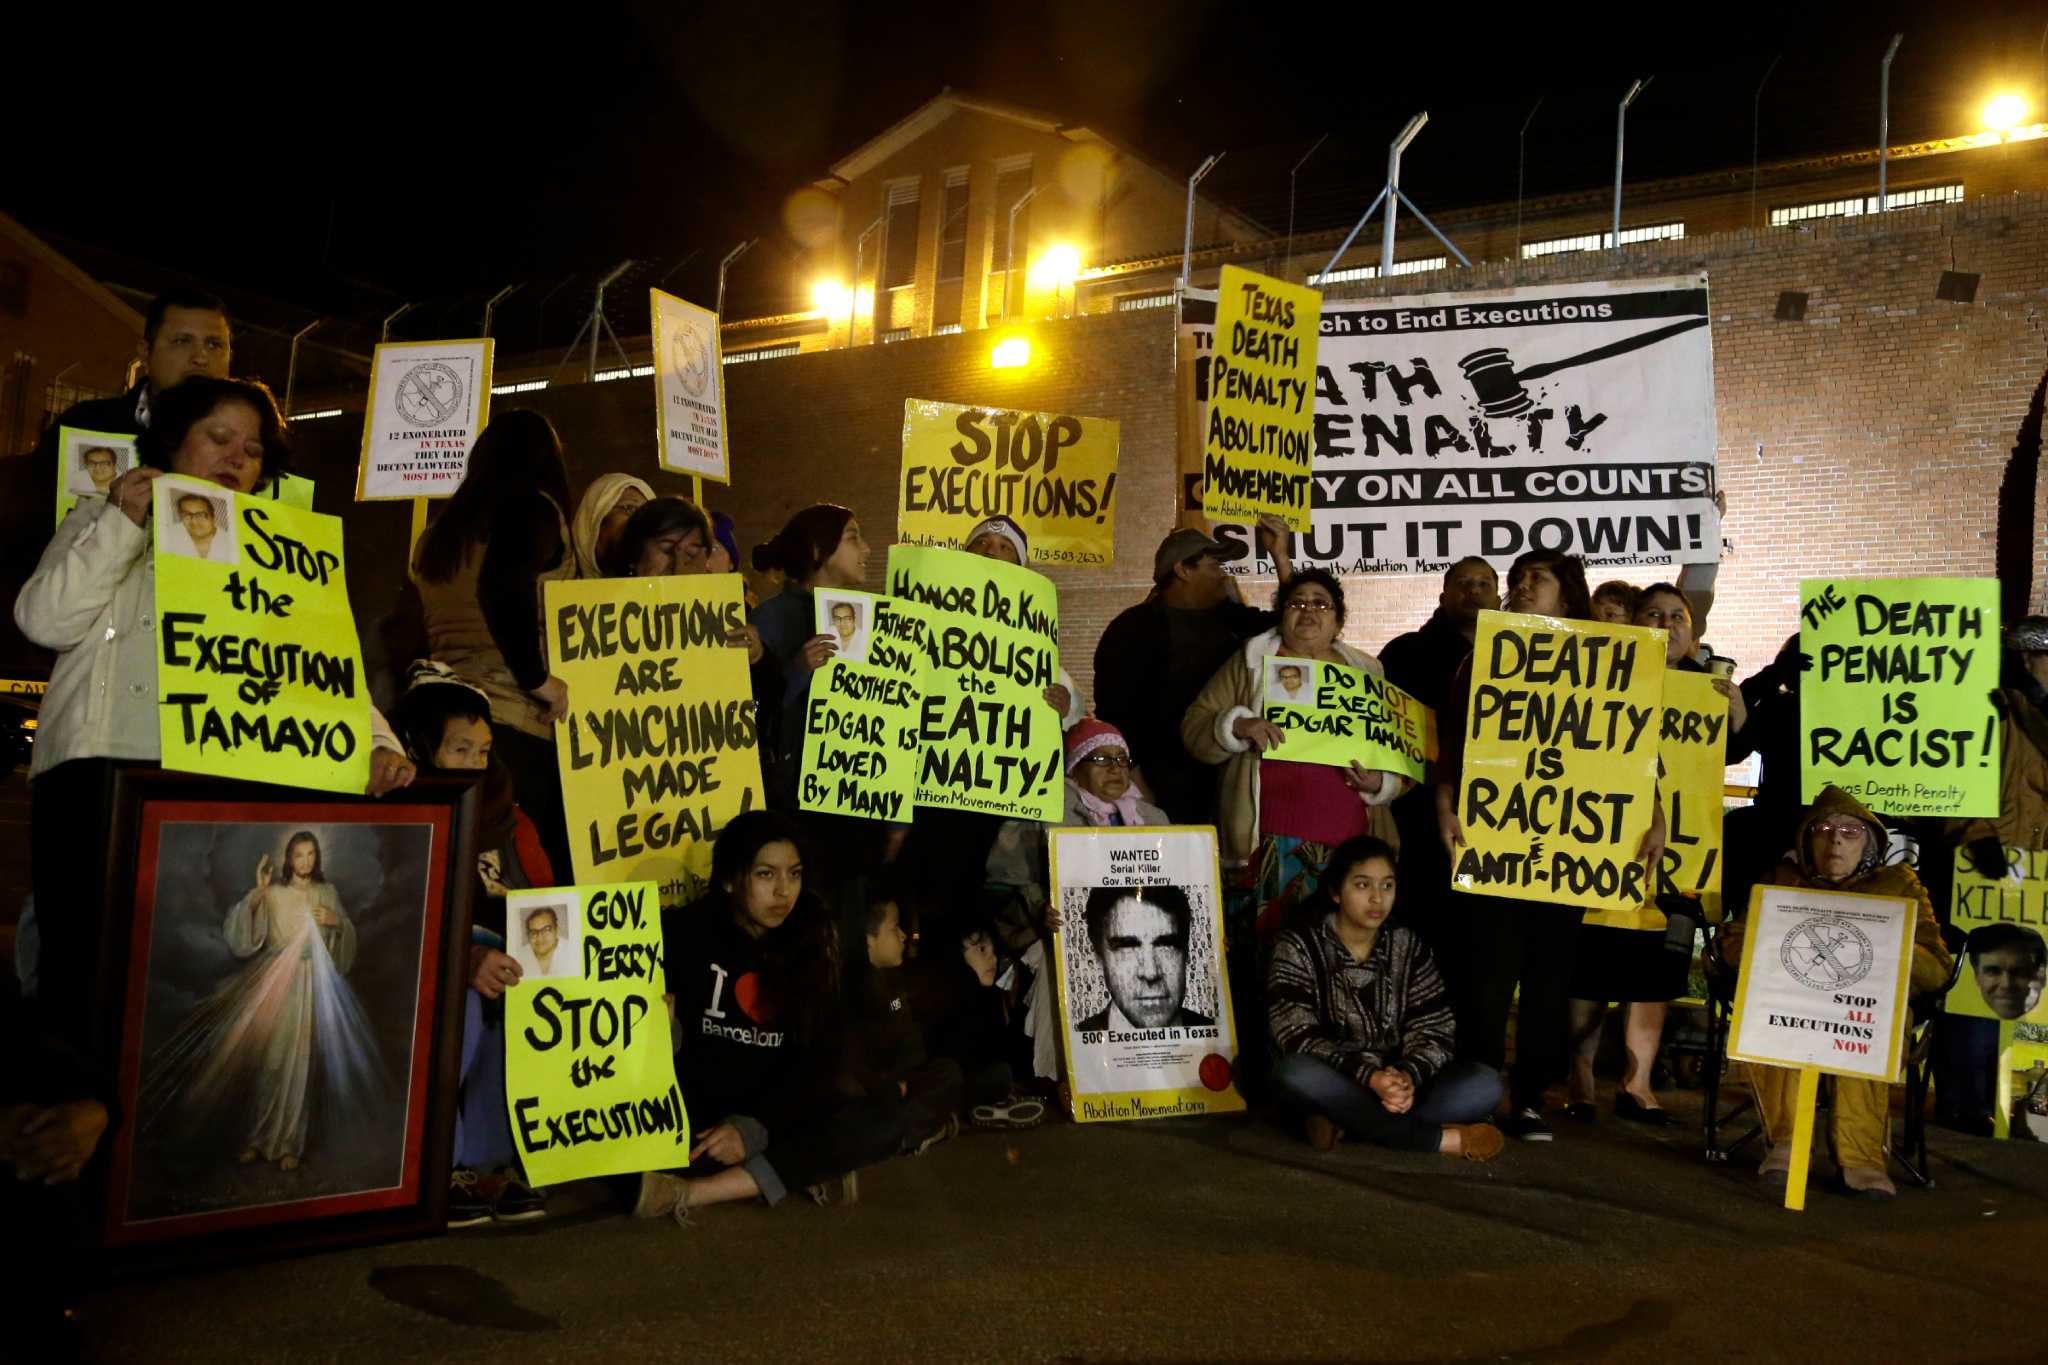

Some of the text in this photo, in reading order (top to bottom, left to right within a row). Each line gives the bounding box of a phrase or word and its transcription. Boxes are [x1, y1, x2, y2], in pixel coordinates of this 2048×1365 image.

[1241, 283, 1295, 331] TEXAS
[1360, 313, 1388, 331] to
[1396, 308, 1447, 330] End
[1455, 301, 1614, 326] Executions
[1232, 320, 1299, 369] DEATH
[1212, 355, 1308, 414] PENALTY
[388, 429, 466, 441] 12 EXONERATED
[420, 440, 465, 449] IN TEXAS
[950, 408, 1083, 474] STOP
[1208, 406, 1310, 467] ABOLITION
[1314, 404, 1609, 459] ENALTY
[377, 461, 463, 472] DECENT LAWYERS
[402, 472, 428, 481] MOST
[414, 450, 464, 460] THEY HAD
[905, 465, 1117, 524] EXECUTIONS!
[1204, 453, 1310, 509] MOVEMENT
[1356, 475, 1421, 501] ON
[1434, 471, 1515, 499] ALL
[1524, 466, 1708, 497] COUNTS
[243, 508, 339, 586] STOP
[1406, 520, 1462, 557] IT
[1480, 514, 1703, 556] DOWN!
[223, 571, 294, 617] the
[893, 568, 977, 616] HONOR
[1802, 584, 1982, 640] THE DEATH
[557, 598, 745, 663] EXECUTIONS
[161, 611, 355, 699] EXECUTION
[614, 656, 683, 696] ARE
[868, 636, 917, 677] SON,
[926, 626, 1052, 689] ABOLISH
[1490, 629, 1637, 692] DEATH
[1821, 643, 1975, 686] PENALTY
[238, 678, 282, 705] OF
[958, 672, 997, 696] the
[1323, 664, 1413, 718] DO NOT
[160, 693, 356, 763] TAMAYO
[808, 698, 919, 750] EDGAR IS
[919, 694, 1032, 750] EATH
[1317, 686, 1417, 740] EXECUTE
[1472, 684, 1653, 755] PENALTY
[1882, 691, 1919, 724] IS
[568, 699, 760, 770] LYNCHINGS
[1266, 706, 1425, 765] EDGAR TAMAYO
[1810, 715, 1995, 768] RACIST!
[622, 756, 722, 809] MADE
[816, 741, 887, 779] LOVED
[1525, 747, 1565, 781] IS
[837, 778, 904, 821] MANY
[1466, 778, 1634, 845] RACIST
[1866, 780, 1910, 797] Death
[1914, 783, 1967, 802] Penalty
[1884, 799, 1961, 813] Movement
[1109, 849, 1160, 862] WANTED
[1110, 864, 1161, 875] Serial Killer
[1125, 876, 1145, 886] Rick
[1147, 875, 1171, 887] Perry
[587, 887, 647, 930] GOV.
[704, 963, 728, 1019] I
[1833, 993, 1877, 1009] STOP
[523, 986, 648, 1052] STOP
[1108, 1028, 1166, 1044] Executed
[1169, 1027, 1181, 1040] in
[1184, 1025, 1219, 1040] Texas
[1769, 1014, 1873, 1040] EXECUTIONS
[1845, 1010, 1875, 1025] ALL
[1833, 1039, 1870, 1055] NOW
[569, 1054, 616, 1088] the
[514, 1083, 684, 1153] EXECUTION!
